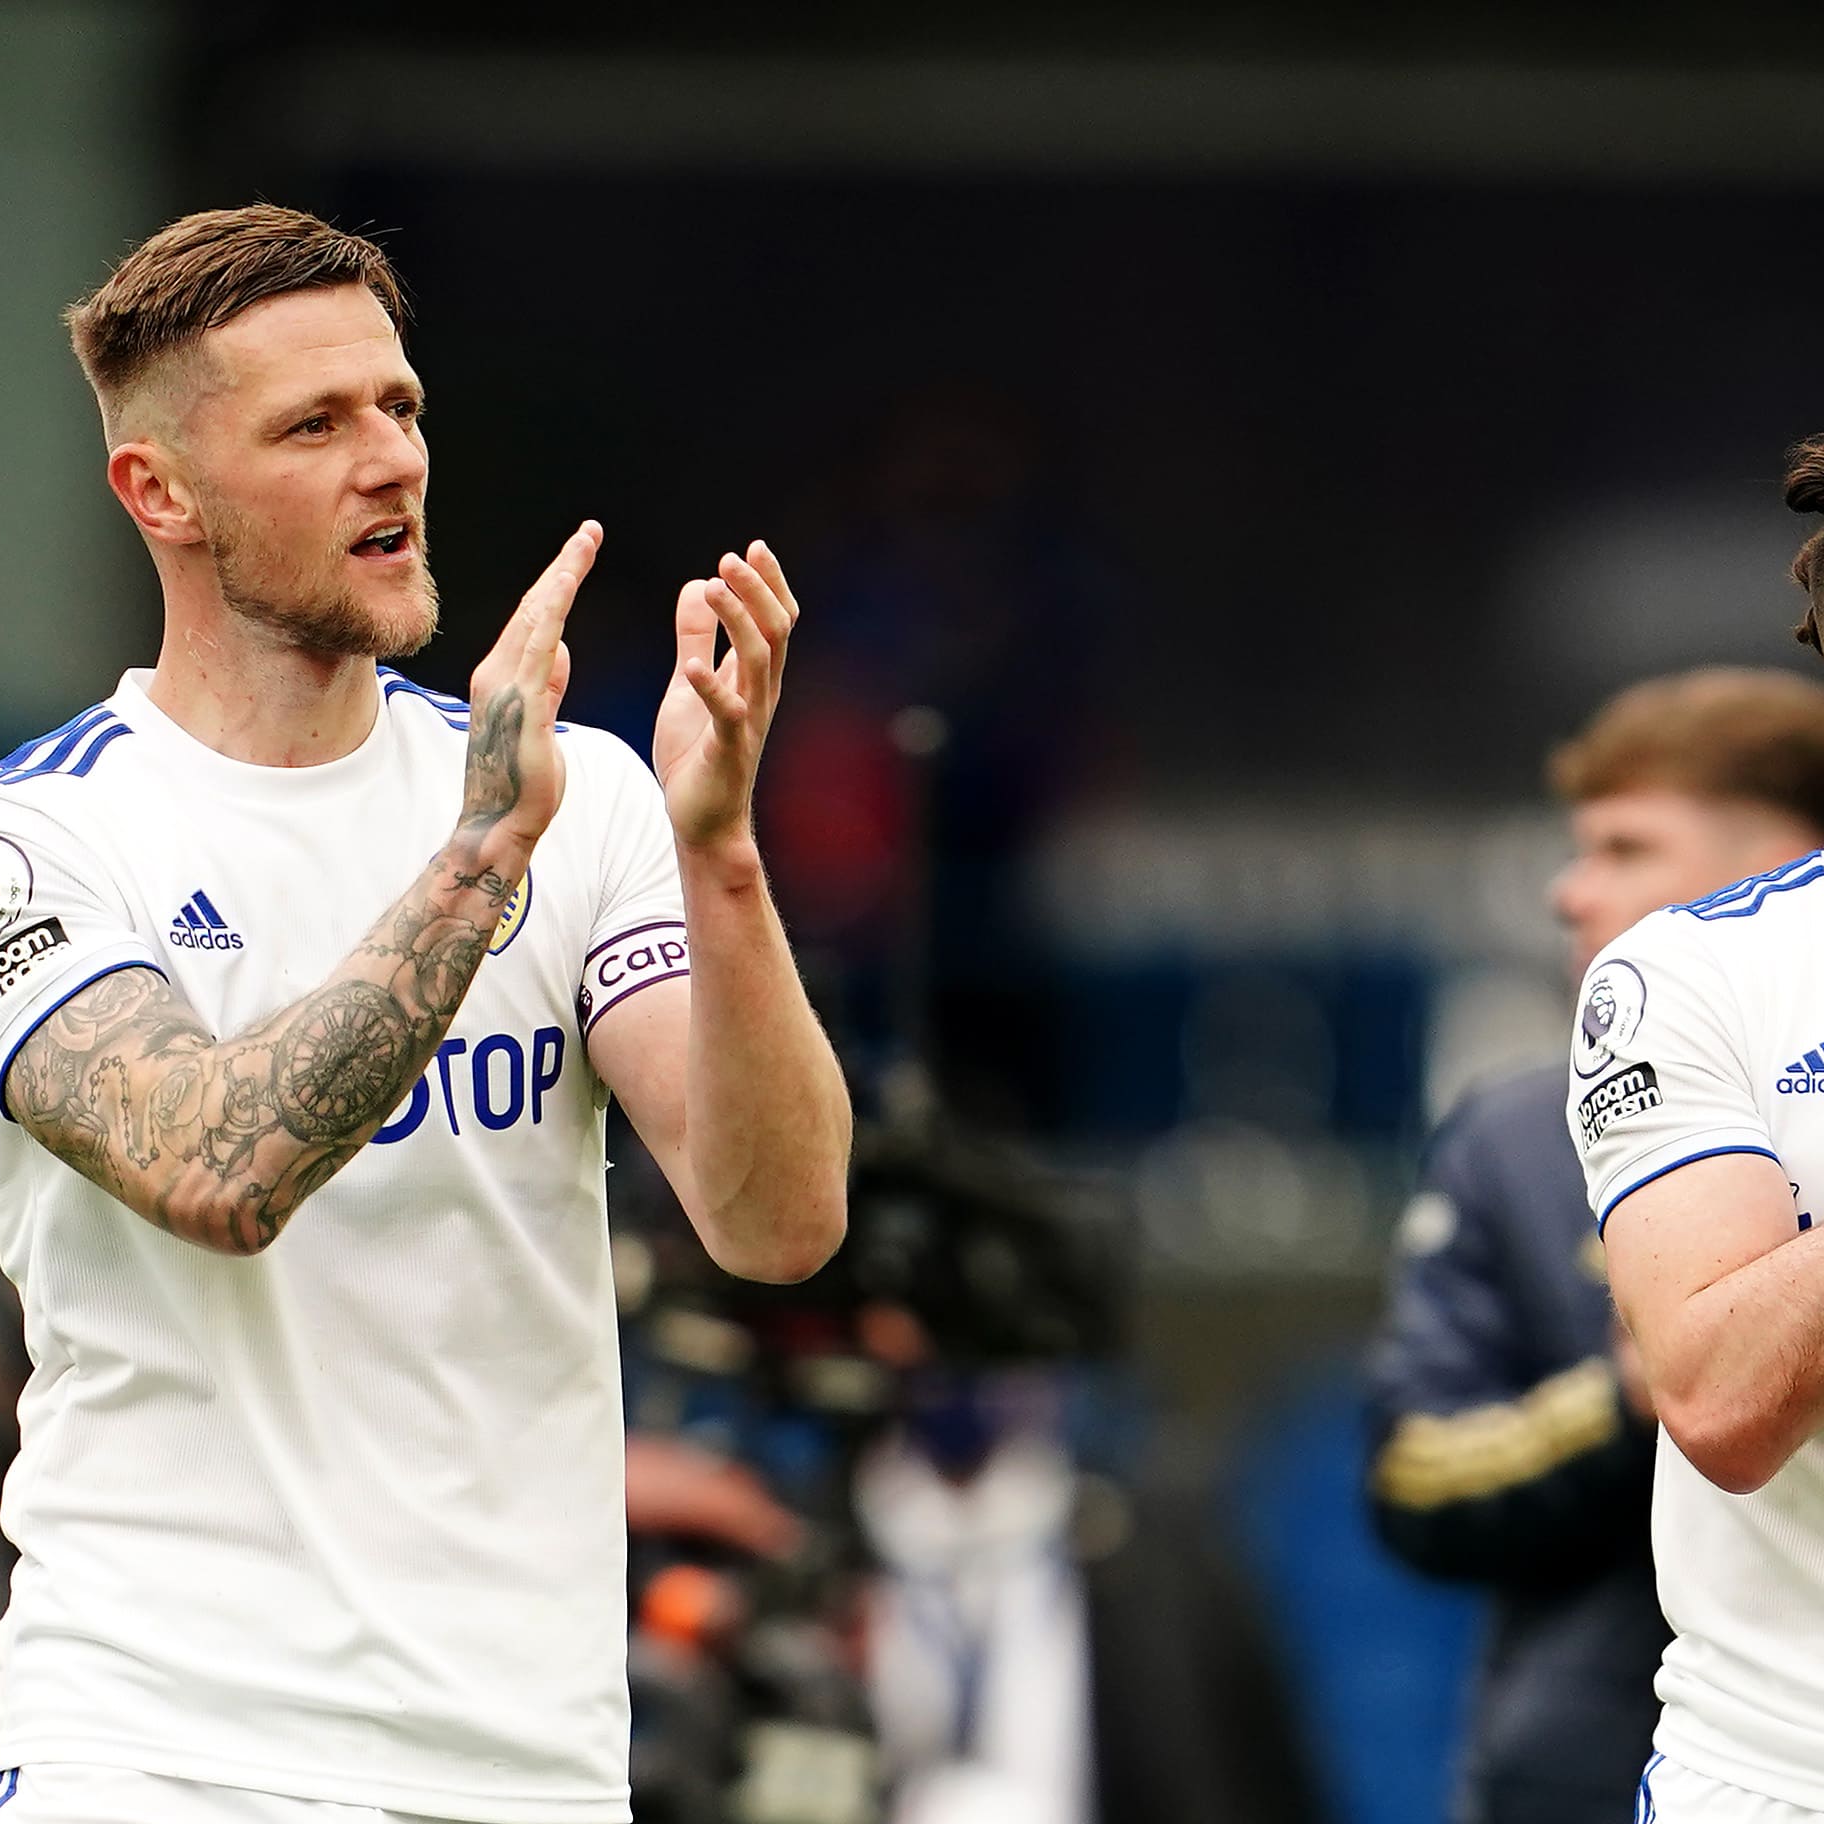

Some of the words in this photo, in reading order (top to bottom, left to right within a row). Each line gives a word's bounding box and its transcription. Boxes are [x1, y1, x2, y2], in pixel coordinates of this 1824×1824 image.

[170, 927, 244, 949] adidas
[1591, 1070, 1645, 1114] room
[1595, 1086, 1663, 1133] racism
